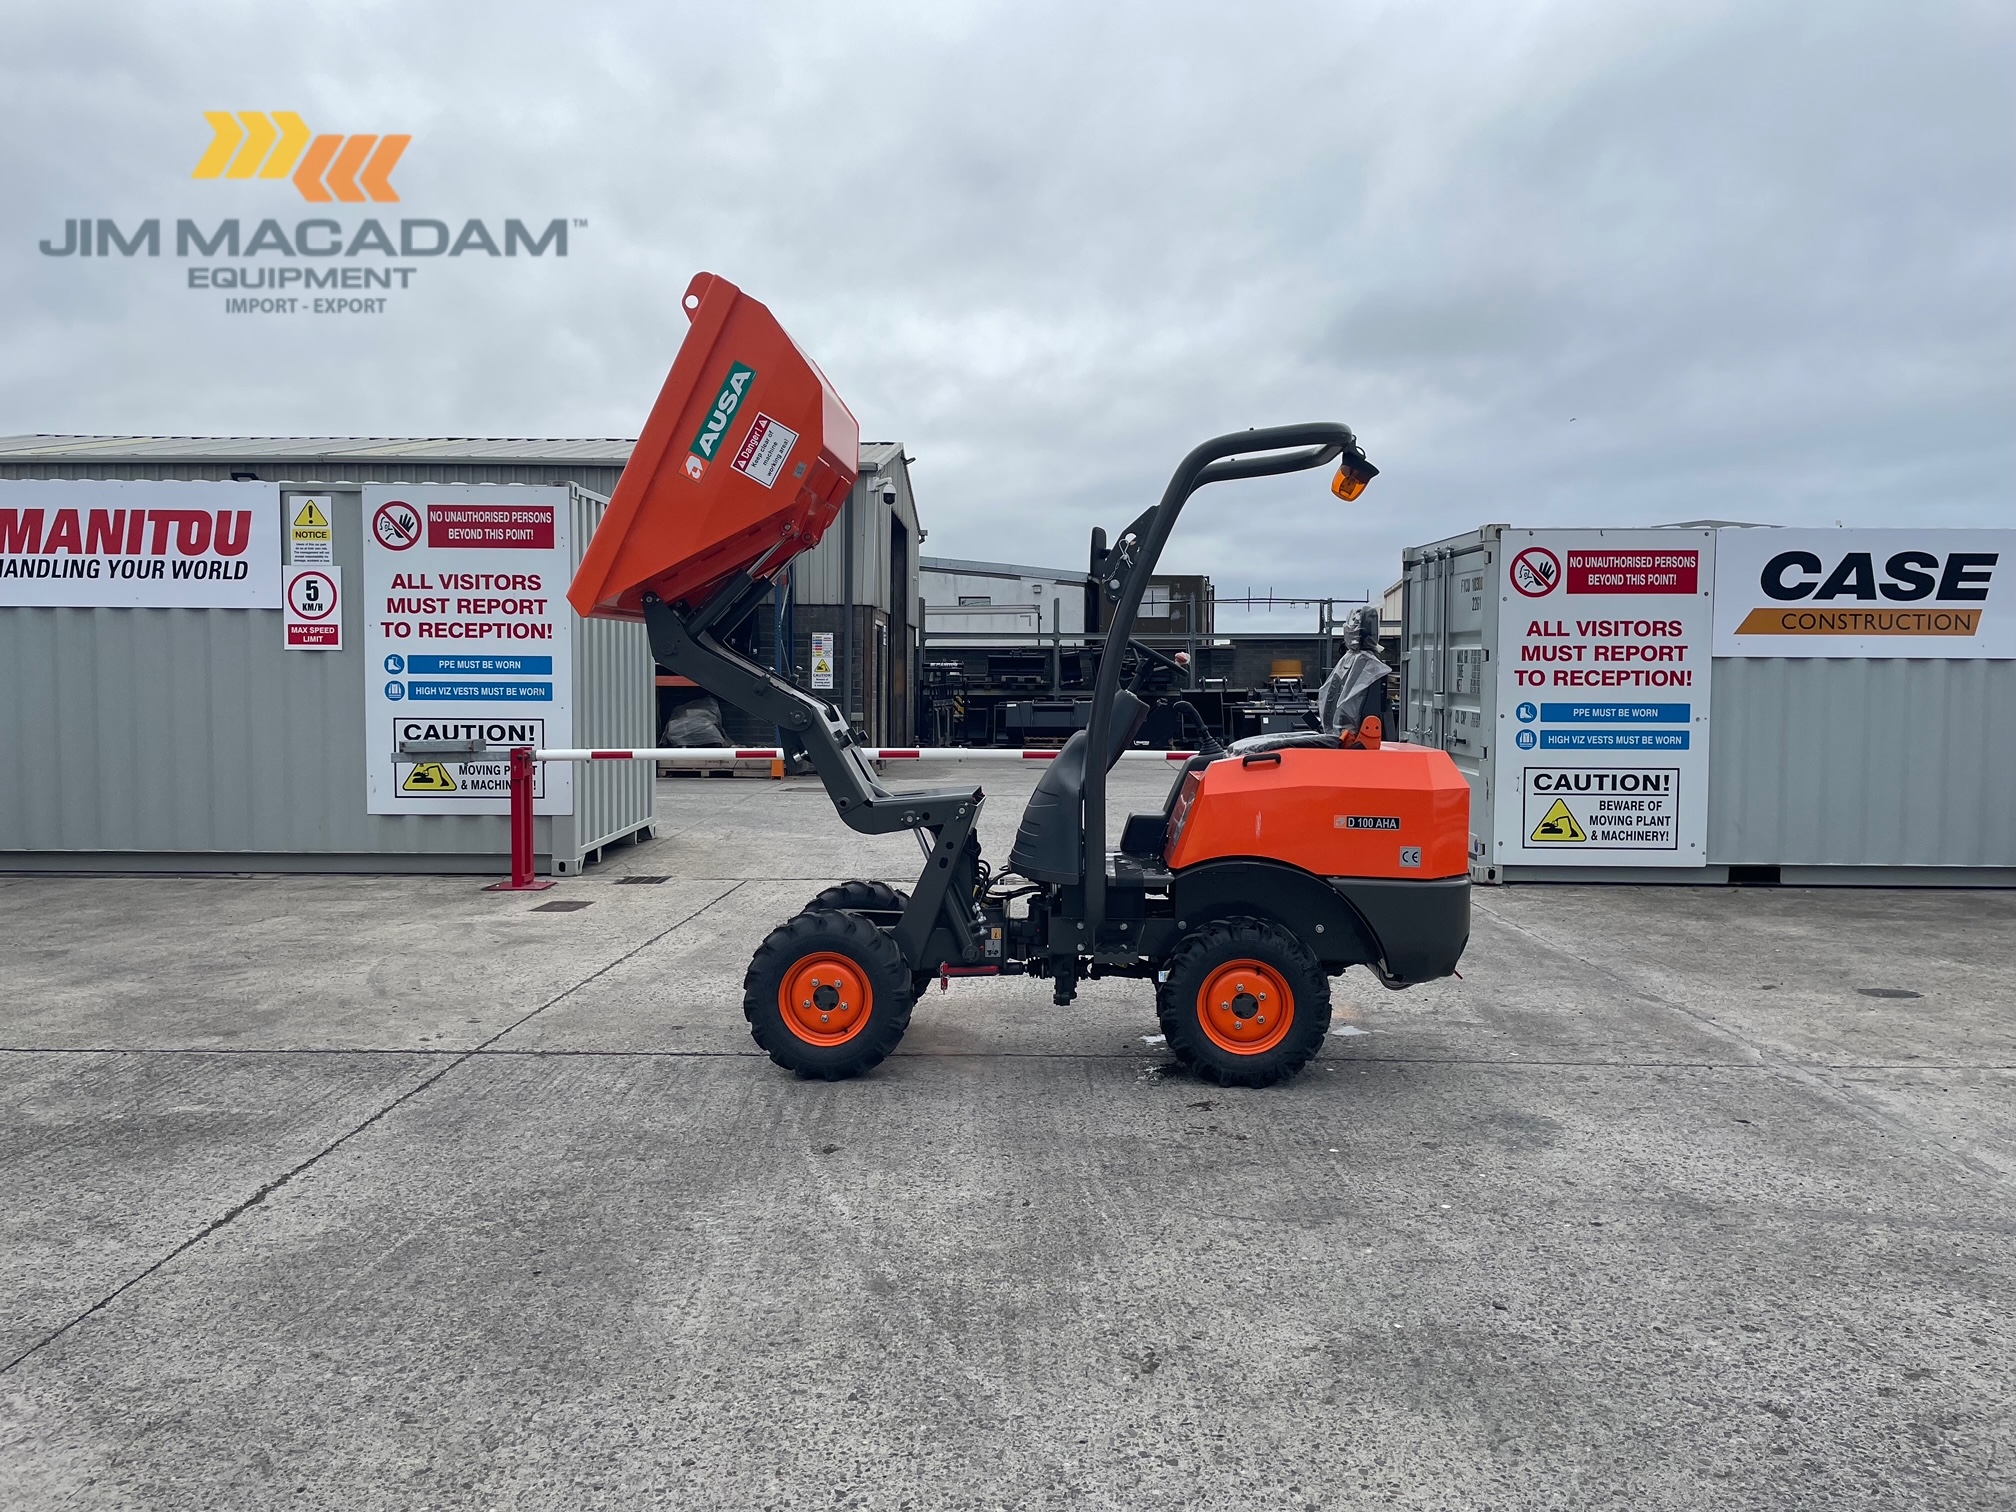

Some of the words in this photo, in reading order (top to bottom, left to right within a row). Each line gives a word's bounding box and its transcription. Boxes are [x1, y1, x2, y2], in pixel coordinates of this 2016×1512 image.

[699, 372, 751, 456] AUSA
[751, 452, 762, 467] Keep
[761, 438, 770, 452] clear
[763, 442, 778, 465] machine
[767, 454, 782, 476] working
[779, 439, 789, 454] area!
[430, 511, 442, 522] NO
[445, 511, 509, 522] UNAUTHORISED
[512, 512, 551, 523] PERSONS
[0, 509, 252, 556] MANITOU
[449, 529, 482, 539] BEYOND
[485, 529, 503, 540] THIS
[506, 530, 533, 540] POINT!
[0, 558, 100, 579] ANDLING
[108, 560, 165, 579] YOUR
[172, 560, 248, 580] WORLD
[1570, 556, 1583, 567] NO
[1585, 556, 1652, 567] UNAUTHORISED
[1655, 557, 1696, 567] PERSONS
[391, 574, 433, 589] ALL
[439, 574, 541, 590] VISITORS
[1588, 574, 1623, 585] BEYOND
[1626, 575, 1645, 585] THIS
[1648, 575, 1677, 585] POINT!
[1760, 551, 1999, 601] CASE
[306, 580, 319, 601] 5
[302, 603, 323, 611] KM/H
[387, 598, 449, 614] MUST
[457, 599, 547, 614] REPORT
[381, 622, 411, 638] TO
[419, 623, 552, 639] RECEPTION!
[1527, 621, 1570, 636] ALL
[1576, 621, 1683, 637] VISITORS
[1781, 614, 1971, 631] CONSTRUCTION
[1521, 646, 1587, 662] MUST
[1594, 646, 1688, 662] REPORT
[439, 661, 455, 669] PPE
[457, 661, 480, 669] MUST
[482, 661, 493, 669] BE
[496, 661, 521, 669] WORN
[1514, 670, 1545, 686] TO
[1553, 670, 1692, 687] RECEPTION!
[416, 687, 436, 695] HIGH
[439, 687, 451, 695] VIZ
[453, 687, 479, 695] VESTS
[481, 687, 504, 695] MUST
[519, 688, 545, 696] WORN
[1592, 709, 1616, 717] MUST
[1618, 709, 1629, 717] BE
[1632, 709, 1658, 717] WORN
[403, 724, 535, 742] CAUTION!
[1548, 736, 1569, 744] HIGH
[1572, 736, 1585, 744] VIZ
[1587, 736, 1614, 744] VESTS
[1616, 736, 1640, 744] MUST
[1642, 736, 1653, 744] BE
[459, 765, 501, 776] MOVING
[461, 780, 468, 790] &
[1534, 774, 1670, 791] CAUTION!
[1599, 800, 1644, 811] BEWARE
[1648, 801, 1662, 811] OF
[1348, 818, 1354, 826] D
[1358, 818, 1373, 827] 100
[1376, 819, 1396, 828] AHA
[1590, 816, 1632, 826] MOVING
[1636, 816, 1671, 826] PLANT
[1591, 831, 1598, 841] &
[1601, 831, 1669, 841] MACHINERY!
[1402, 851, 1418, 863] CE
